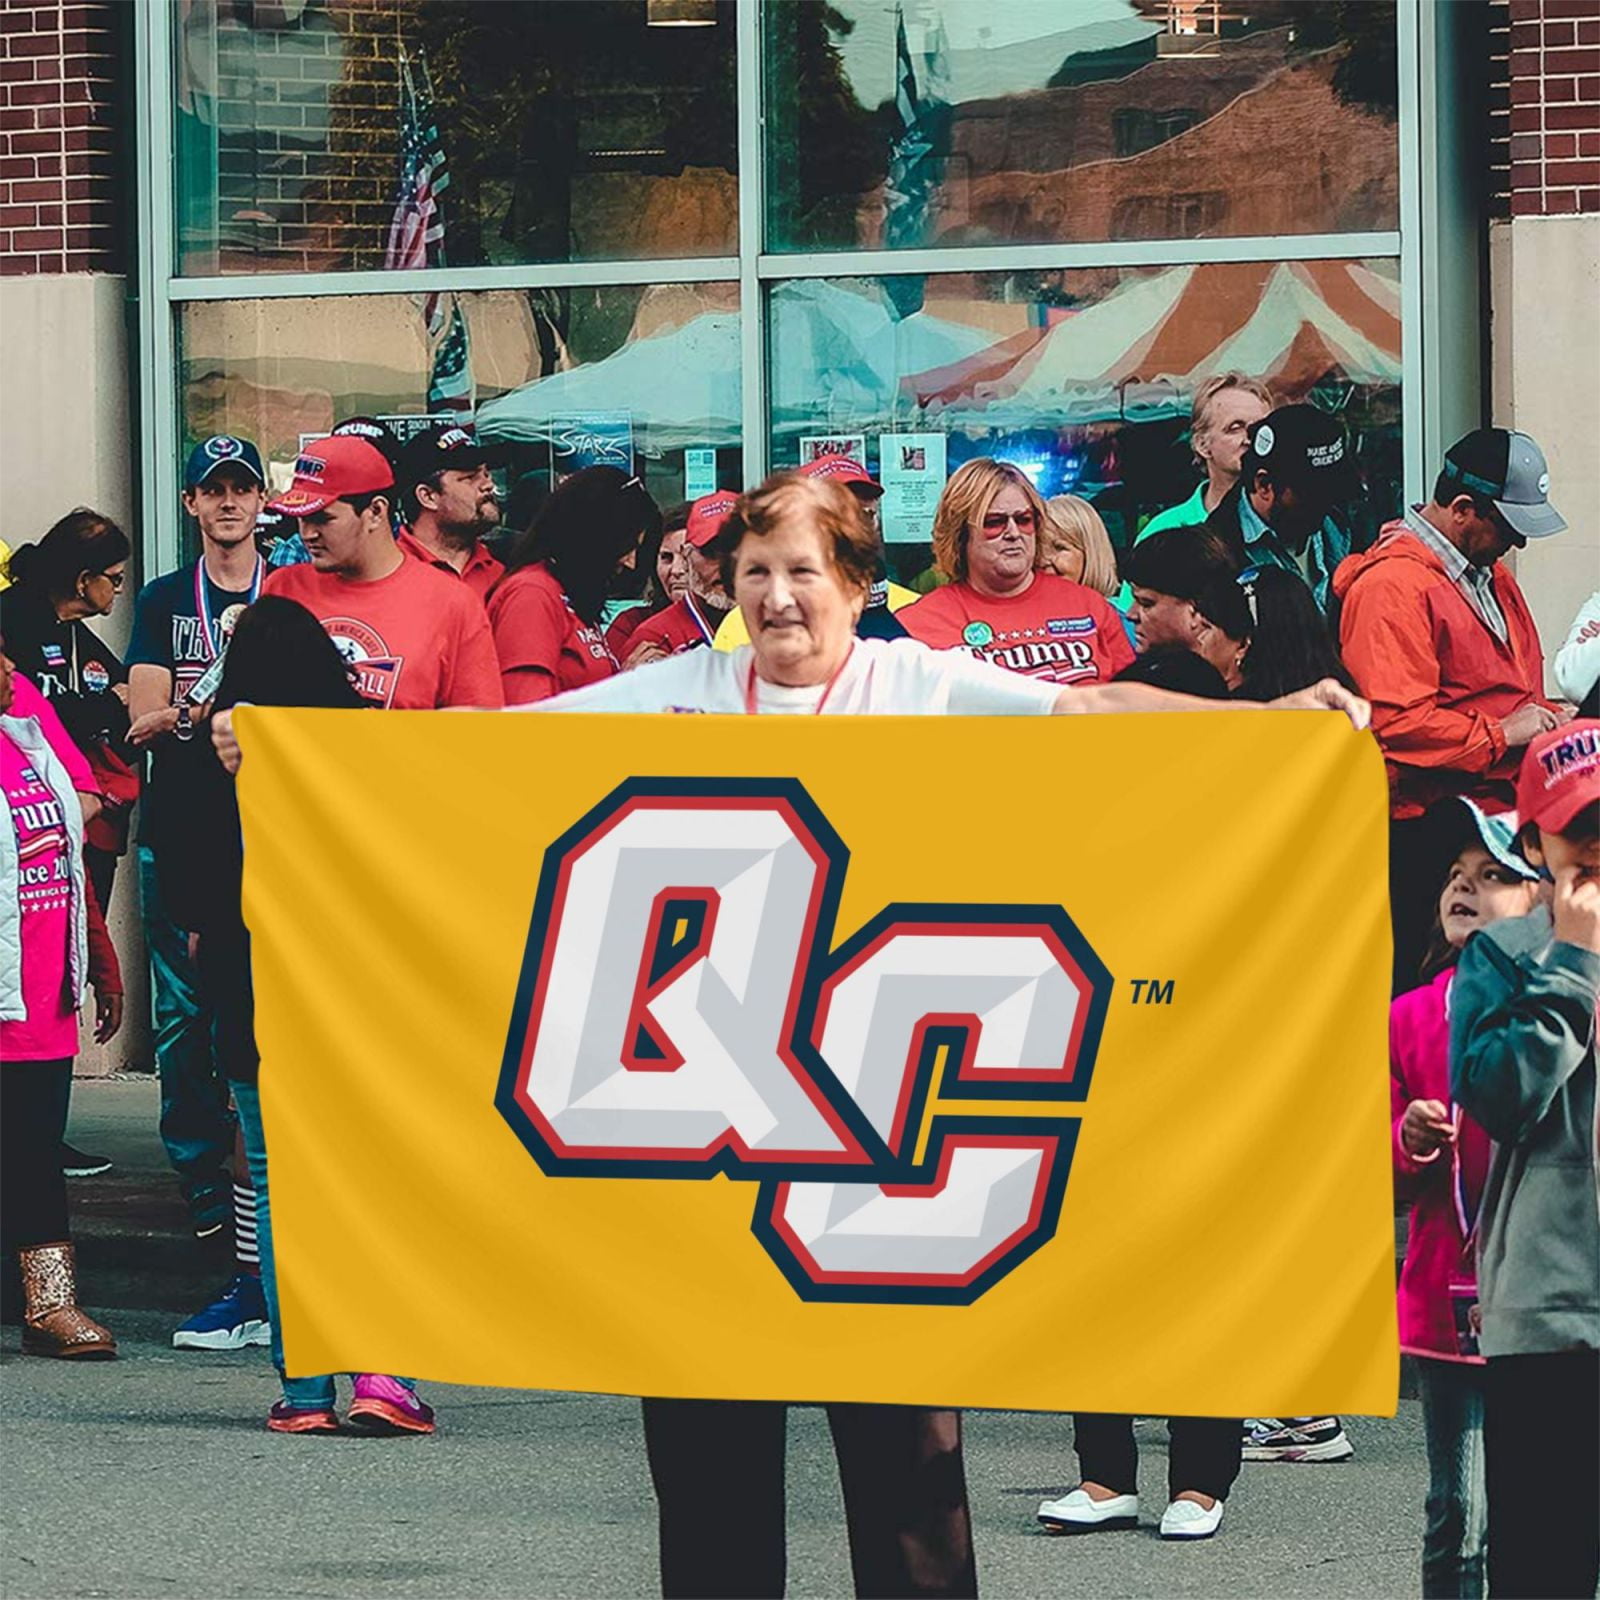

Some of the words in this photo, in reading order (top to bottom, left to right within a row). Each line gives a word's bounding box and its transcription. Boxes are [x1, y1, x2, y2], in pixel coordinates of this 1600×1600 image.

[334, 423, 384, 438] TRUMP
[1541, 733, 1597, 776] TRU
[12, 800, 63, 832] rum
[1130, 979, 1175, 1005] TM
